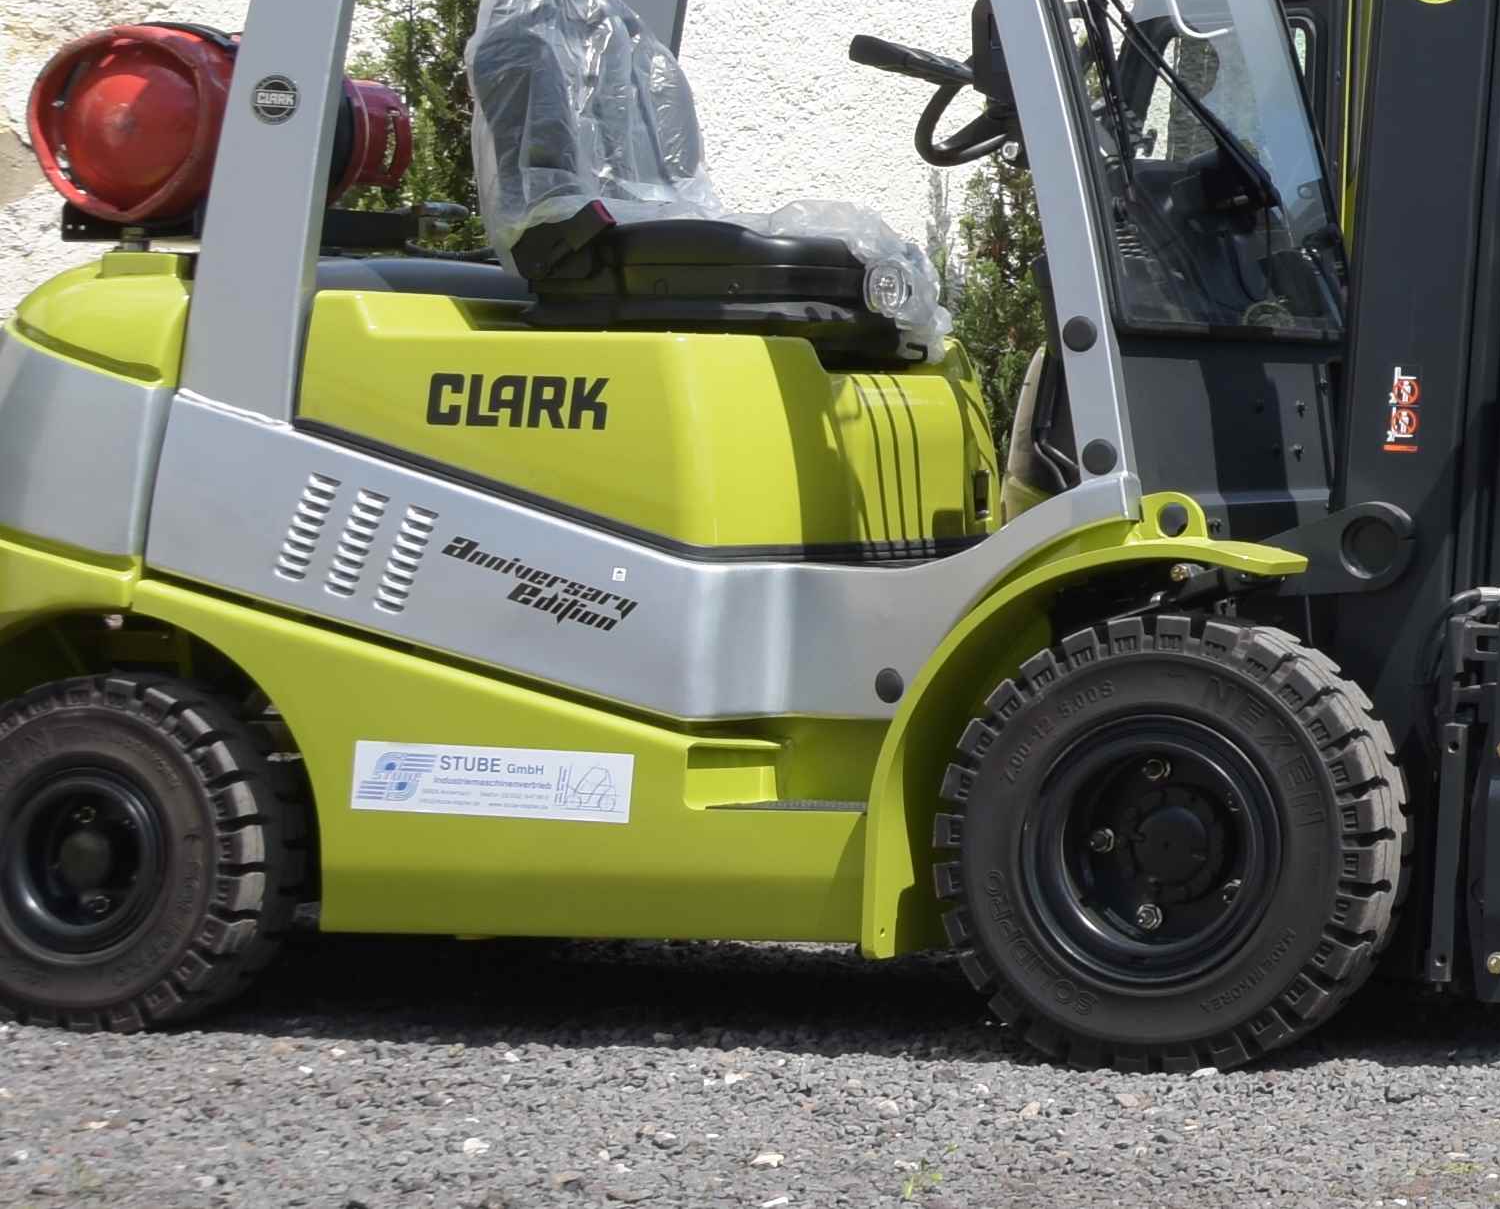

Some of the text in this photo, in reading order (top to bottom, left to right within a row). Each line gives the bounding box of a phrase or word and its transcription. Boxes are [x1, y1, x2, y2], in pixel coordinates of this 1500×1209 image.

[256, 92, 294, 106] CLARK
[427, 372, 609, 431] CLARK
[439, 754, 545, 776] STUBE GmbH
[1198, 676, 1330, 831] NEXEN
